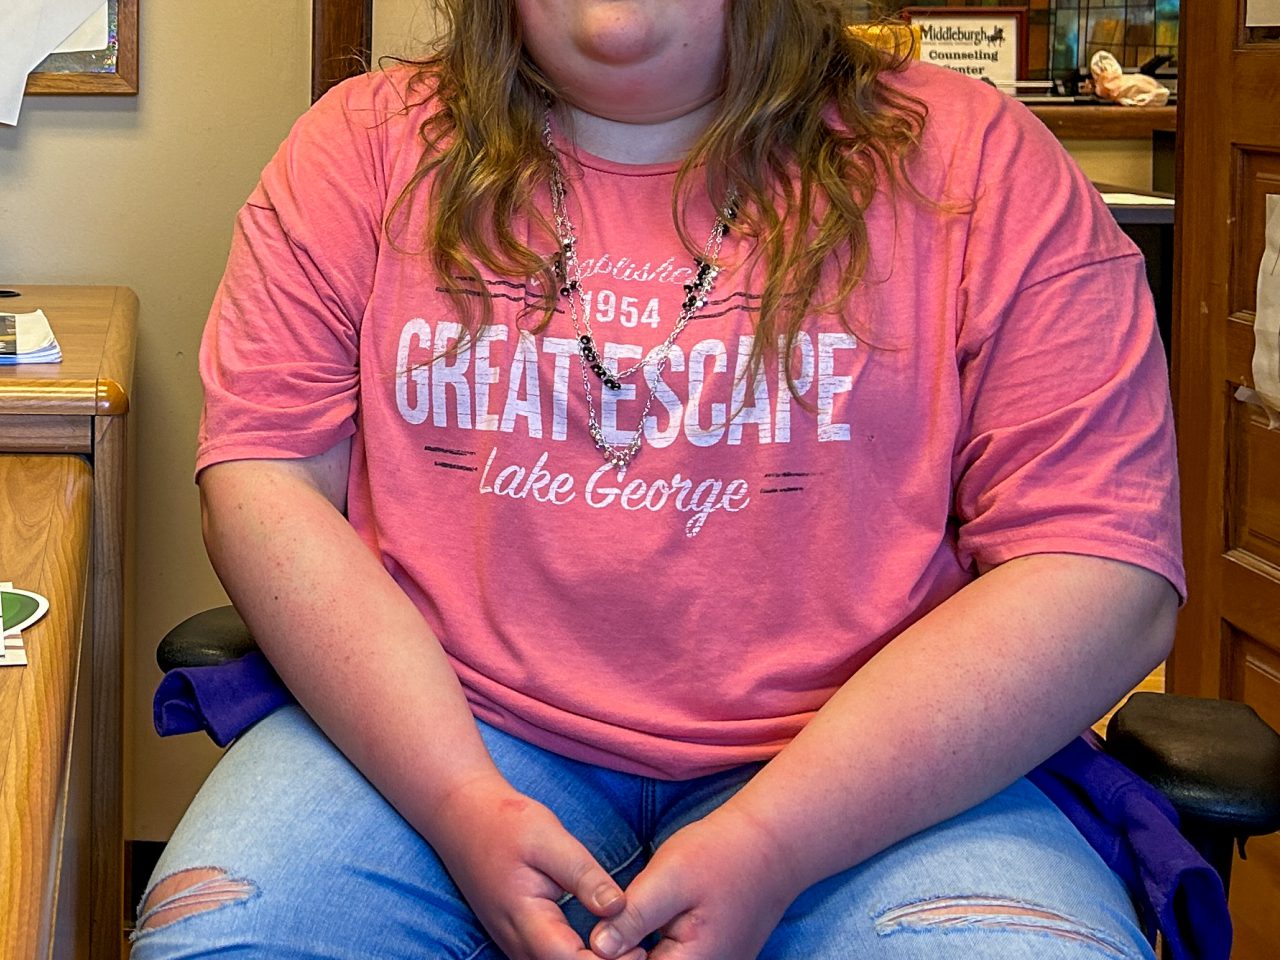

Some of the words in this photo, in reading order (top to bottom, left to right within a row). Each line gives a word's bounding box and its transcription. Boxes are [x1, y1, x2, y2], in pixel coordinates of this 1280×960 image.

[920, 24, 987, 46] Middleburgh
[929, 50, 998, 62] Counseling
[583, 289, 661, 329] 1954
[395, 318, 582, 439] GREAT
[600, 332, 857, 448] ESCAPE
[480, 447, 576, 507] Lake
[586, 462, 752, 538] George
